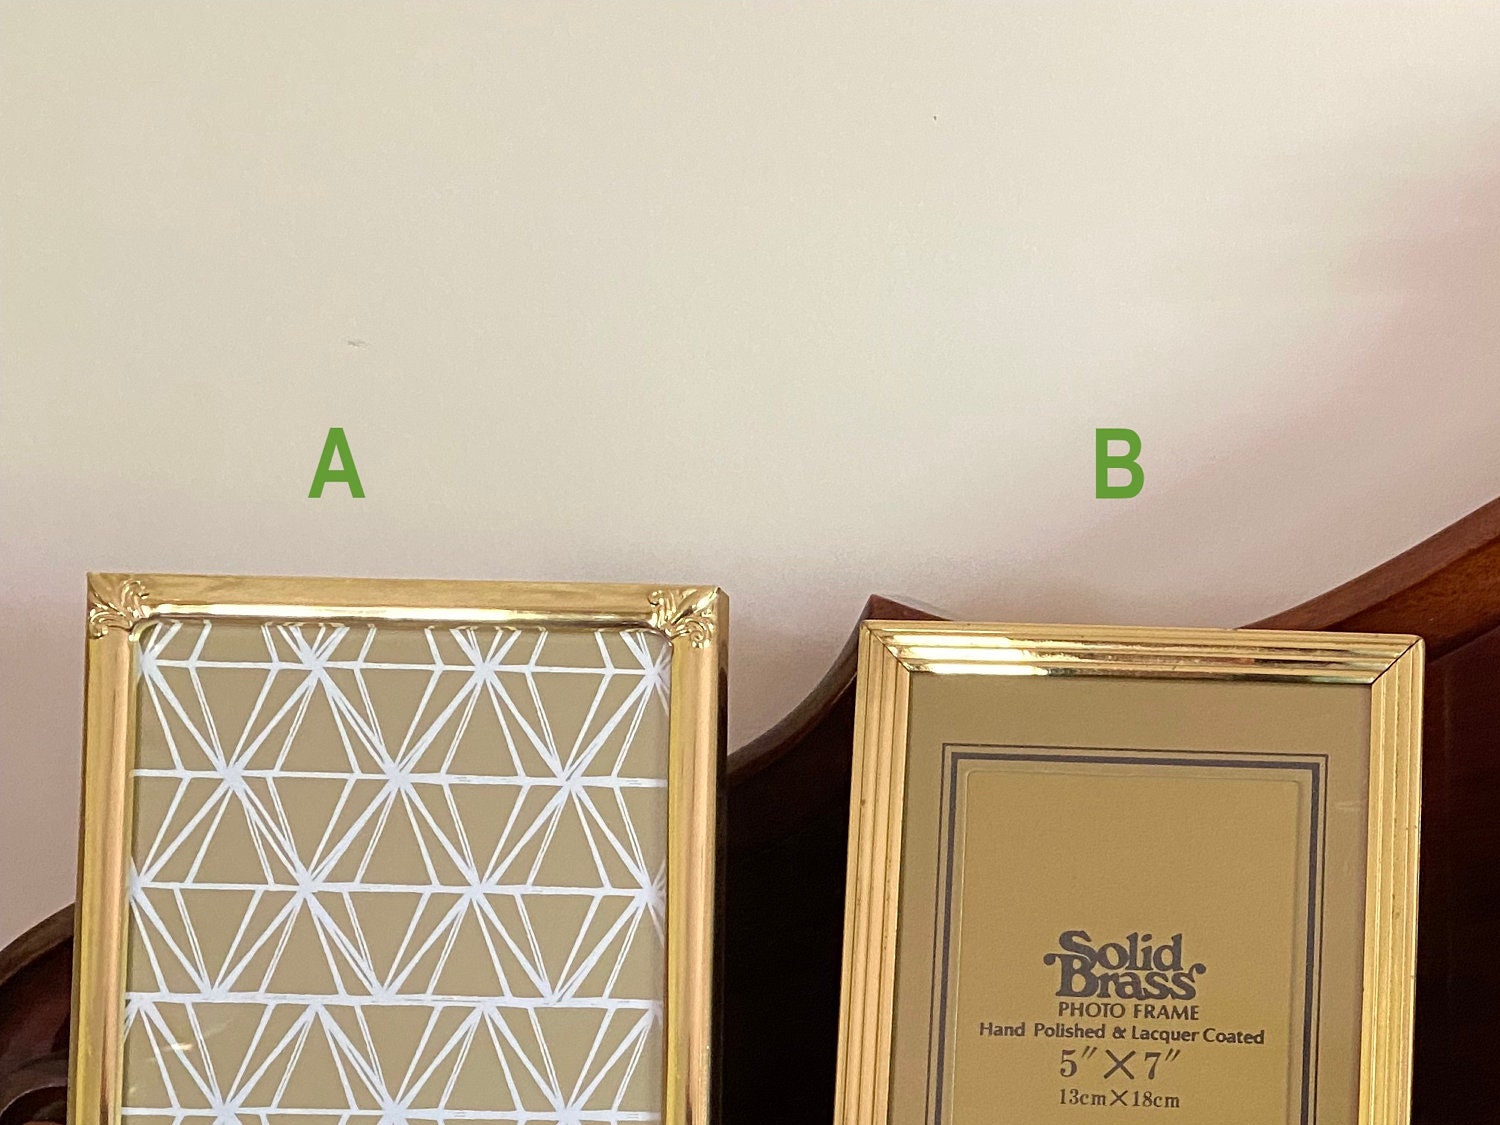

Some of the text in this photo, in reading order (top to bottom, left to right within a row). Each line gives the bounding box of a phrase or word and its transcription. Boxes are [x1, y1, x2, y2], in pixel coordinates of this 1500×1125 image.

[1057, 929, 1184, 972] Solid
[1043, 952, 1207, 1001] Brass
[1057, 1001, 1200, 1021] PHOTO FRAME
[979, 1021, 1265, 1045] Hand Polished & Lacquer Coated
